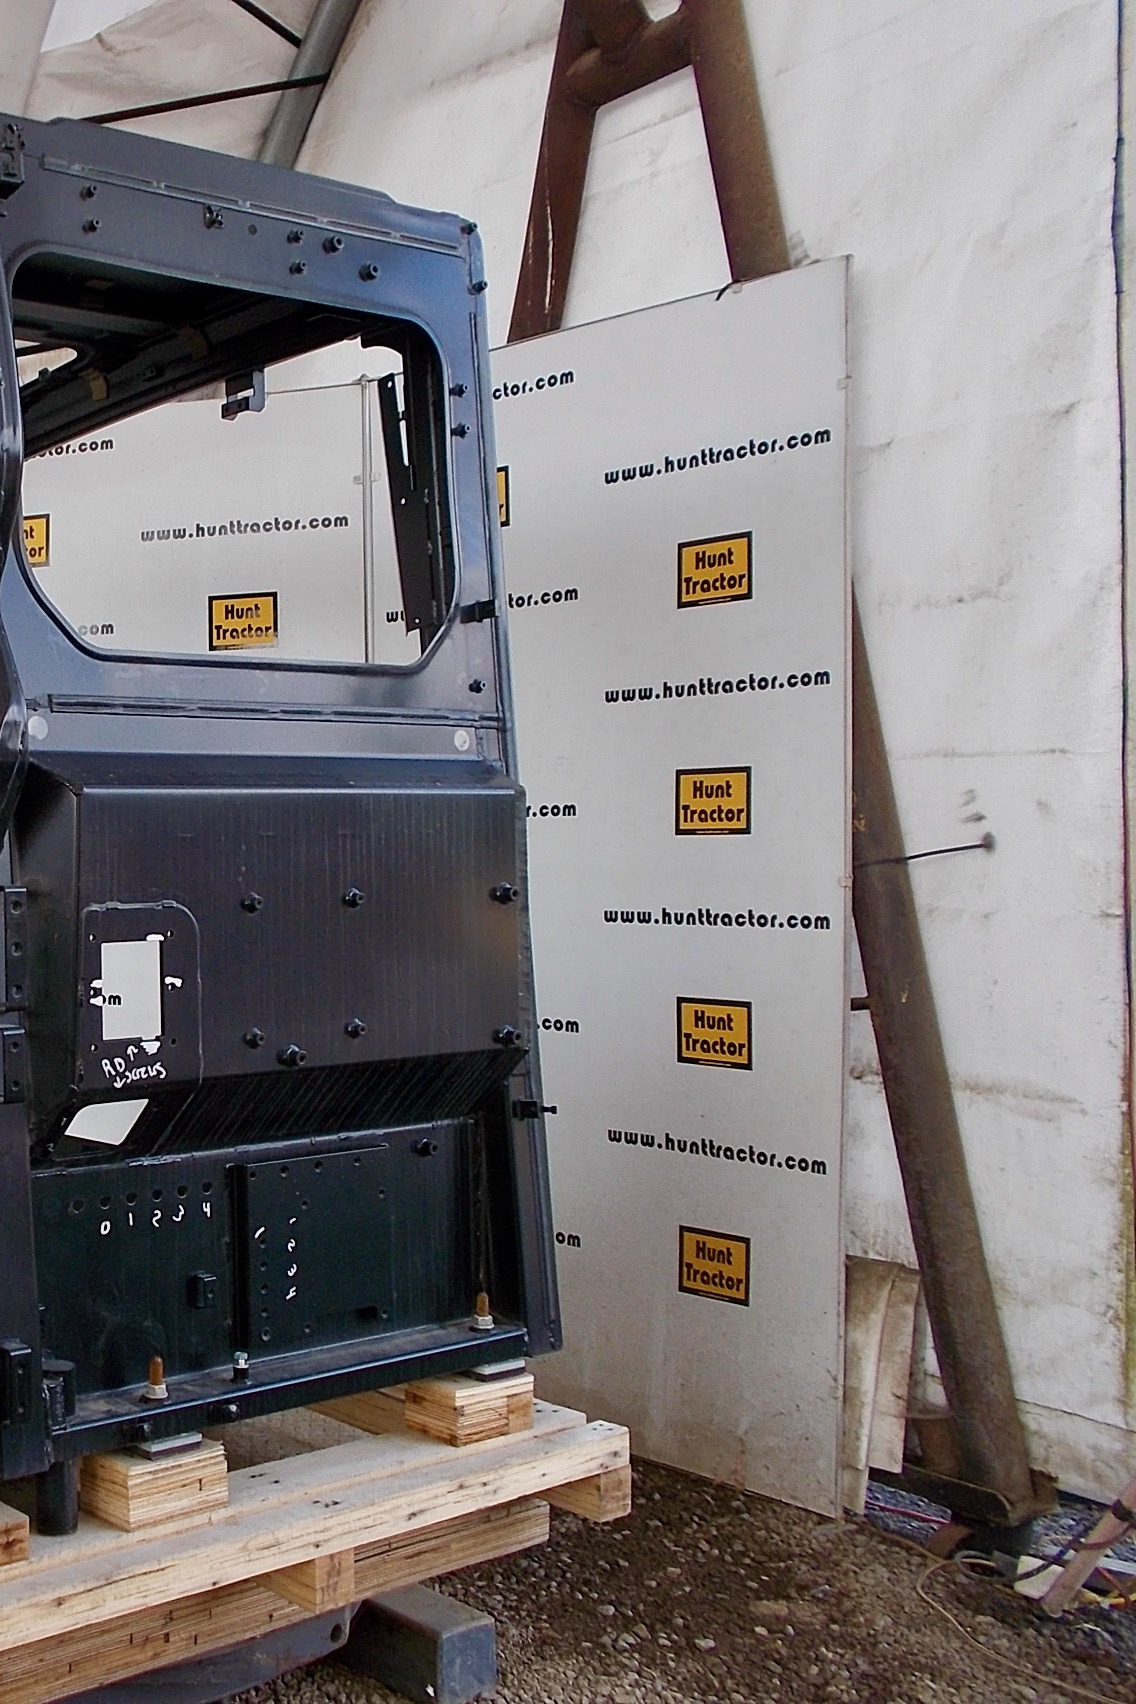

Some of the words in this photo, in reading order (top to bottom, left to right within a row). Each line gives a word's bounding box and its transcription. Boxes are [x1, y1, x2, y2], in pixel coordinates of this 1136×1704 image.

[605, 429, 831, 484] www.hunttractor.com
[141, 516, 348, 541] www.hunttractor.com
[695, 547, 733, 570] Hunt
[685, 573, 746, 595] Tractor
[225, 603, 260, 620] Hunt
[216, 623, 272, 640] Tractor
[605, 671, 830, 703] www.hunttractor.com
[693, 780, 732, 799] Hunt
[683, 805, 744, 823] Tractor
[604, 908, 830, 929] www.hunttractor.com
[694, 1010, 733, 1031] Hunt
[684, 1032, 746, 1056] Tractor
[608, 1130, 826, 1175] www.hunttractor.com
[696, 1240, 732, 1265] Hunt
[686, 1262, 743, 1292] Tractor
